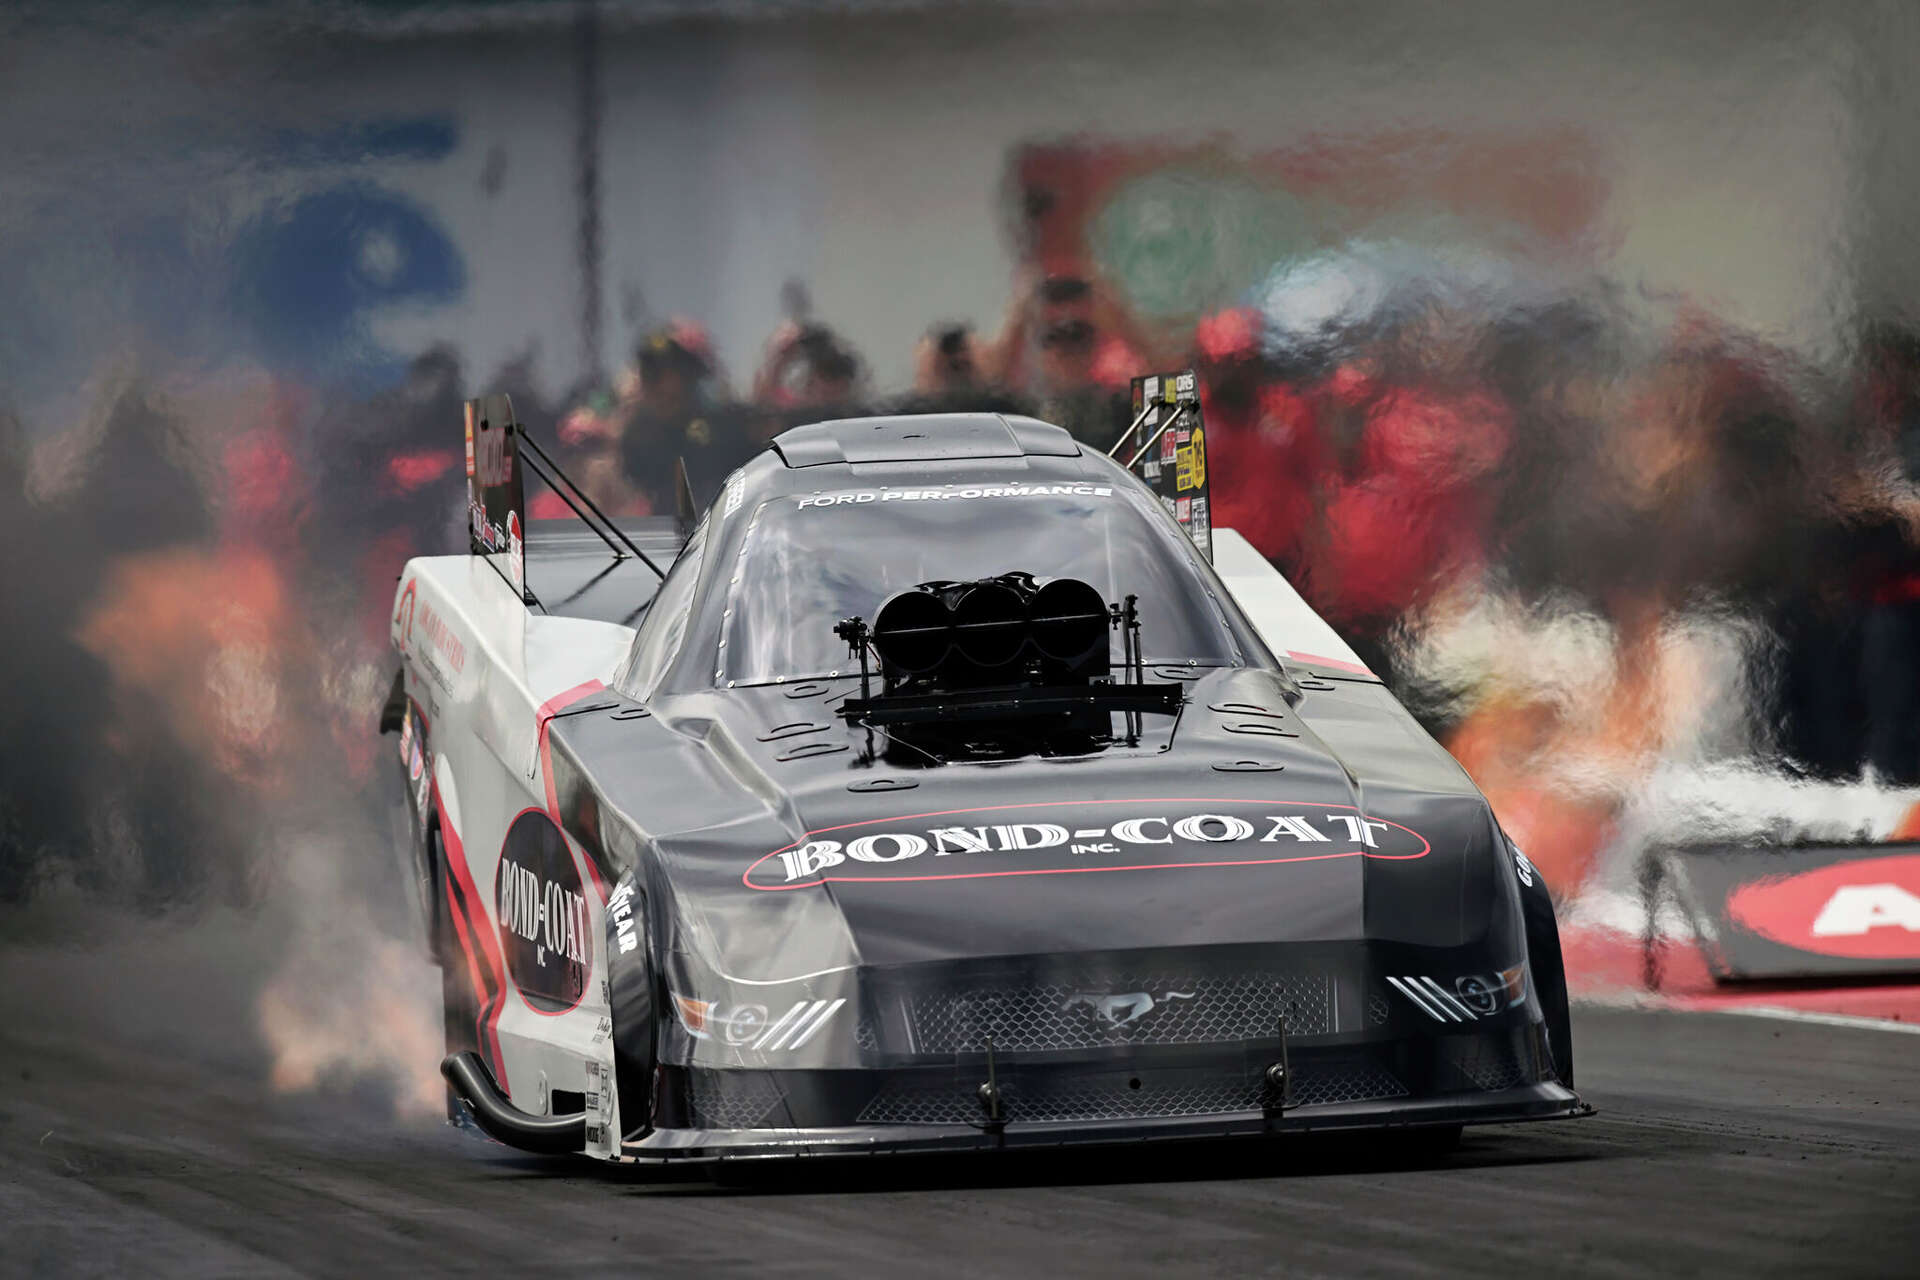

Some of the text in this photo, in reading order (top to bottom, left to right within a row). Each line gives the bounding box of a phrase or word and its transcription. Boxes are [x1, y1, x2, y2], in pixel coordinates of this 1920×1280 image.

[798, 485, 1113, 510] FORD PERFORMANCE
[777, 813, 1389, 882] BOND-COAT
[1070, 842, 1121, 855] INC.
